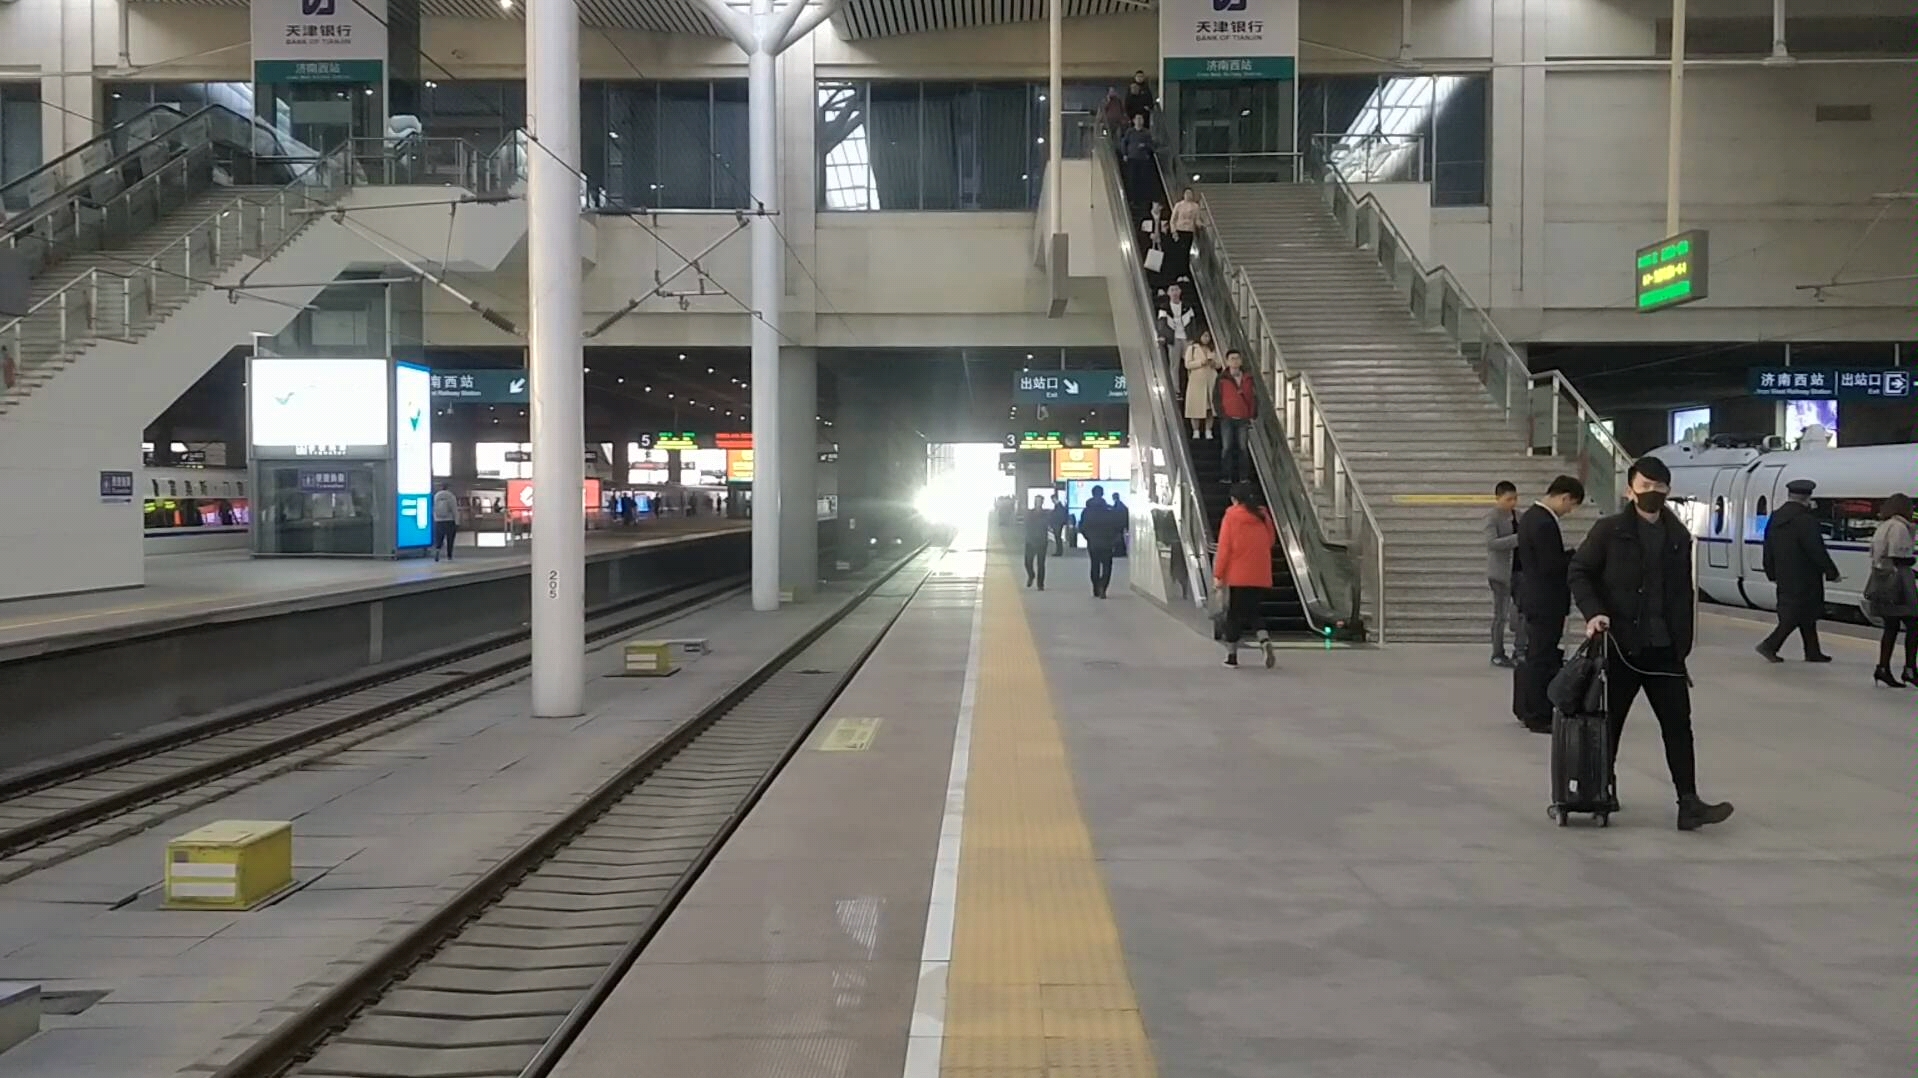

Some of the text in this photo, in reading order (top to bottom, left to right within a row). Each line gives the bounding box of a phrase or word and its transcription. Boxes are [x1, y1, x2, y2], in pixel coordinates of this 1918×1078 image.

[285, 24, 352, 37] 天津银行
[1196, 21, 1264, 33] 天津银行
[1020, 376, 1058, 390] 出站口
[1760, 372, 1825, 387] 济南西站
[1841, 372, 1881, 387] 出站口
[641, 434, 651, 447] 5
[1006, 434, 1016, 446] 3
[549, 570, 558, 599] 205
